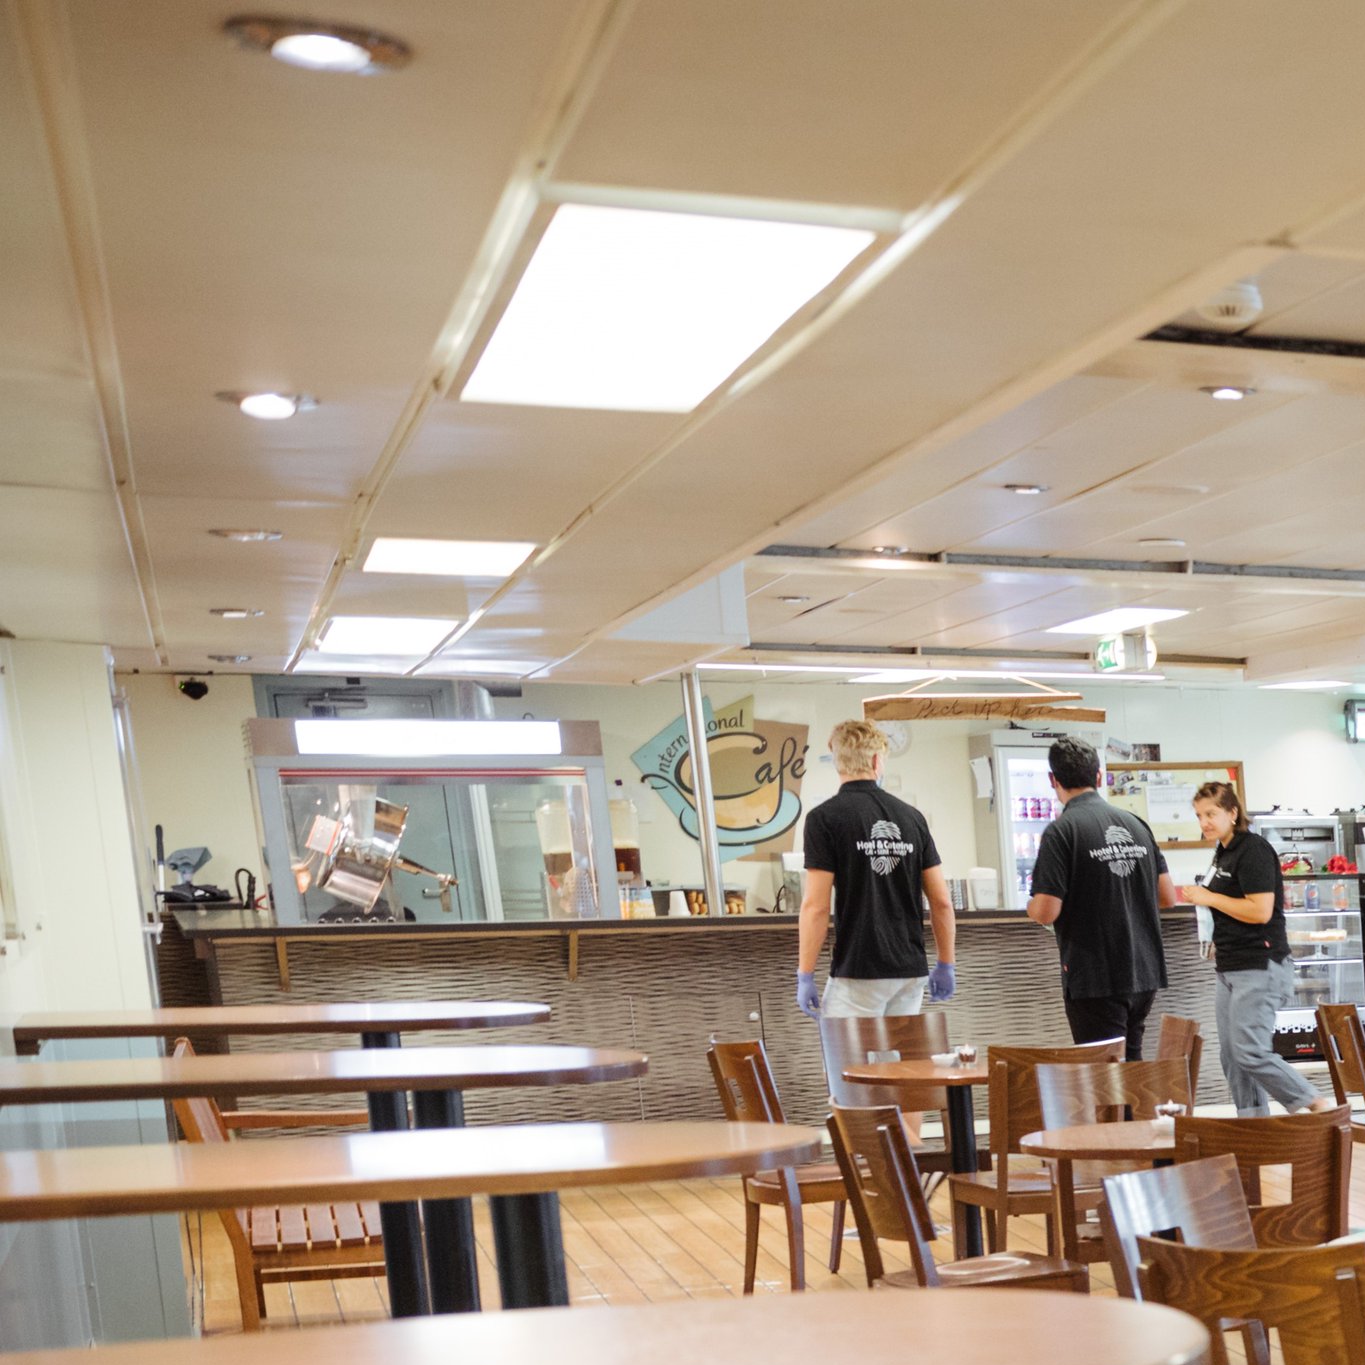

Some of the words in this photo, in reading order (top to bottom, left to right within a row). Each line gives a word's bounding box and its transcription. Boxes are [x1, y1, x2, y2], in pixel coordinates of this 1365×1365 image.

[640, 708, 745, 790] Internonal
[674, 731, 810, 824] Café
[856, 840, 875, 850] Hoel
